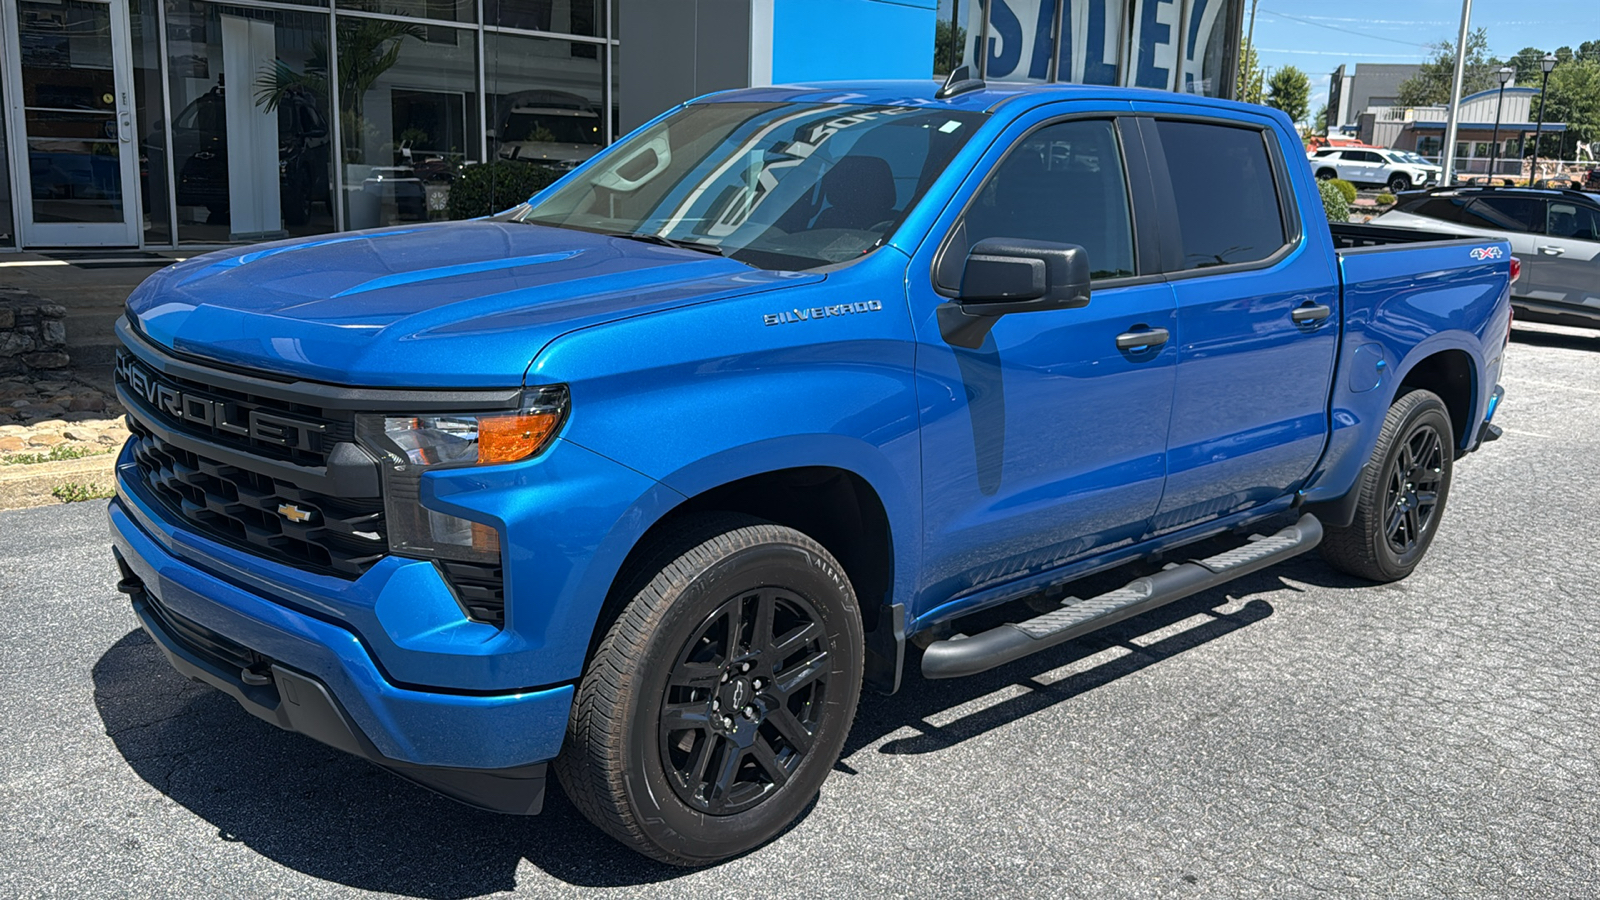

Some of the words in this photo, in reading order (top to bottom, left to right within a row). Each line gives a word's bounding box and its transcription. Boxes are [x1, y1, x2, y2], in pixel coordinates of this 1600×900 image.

[763, 300, 882, 326] SILVERADO
[115, 348, 327, 452] CHEVROLET
[814, 558, 850, 602] ALENZA
